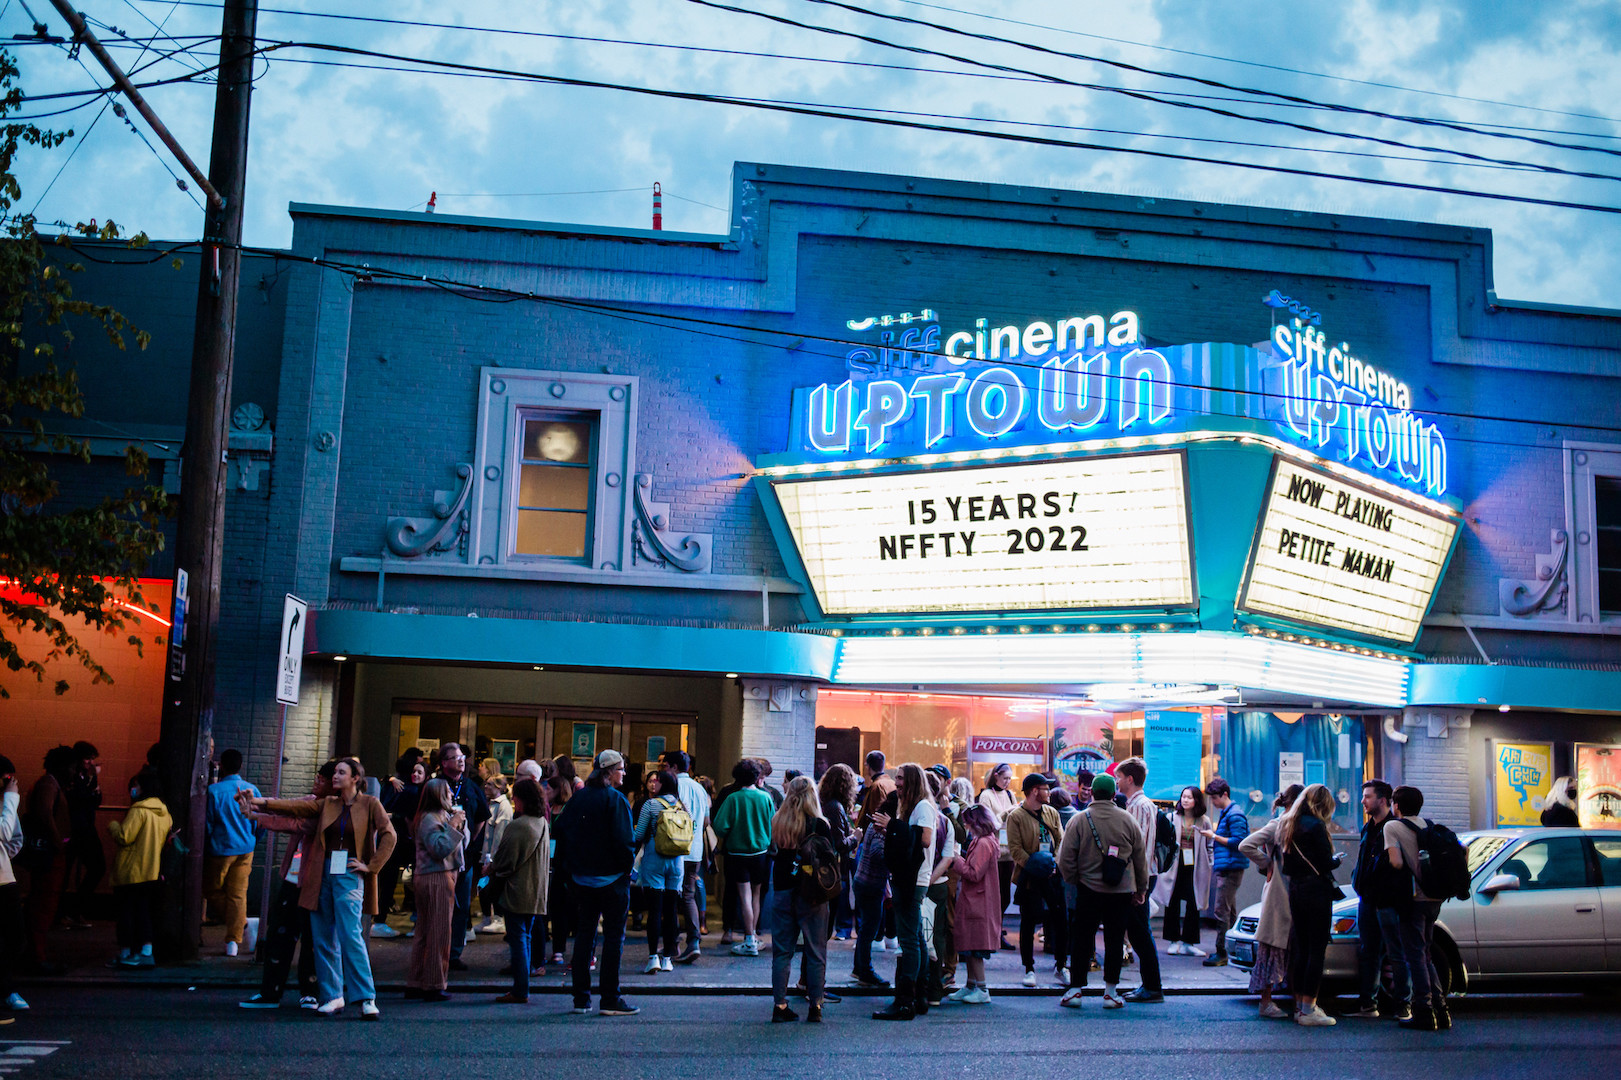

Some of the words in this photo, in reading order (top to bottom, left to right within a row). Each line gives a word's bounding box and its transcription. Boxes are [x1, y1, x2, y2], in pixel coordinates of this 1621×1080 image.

[944, 310, 1140, 366] cinema
[808, 348, 1172, 454] UPTOWN
[1328, 342, 1412, 410] cinema
[1283, 356, 1447, 496] UPTOWN
[908, 499, 937, 526] 15
[945, 491, 1079, 522] YEARS!
[1287, 473, 1326, 509] NOW
[1334, 489, 1393, 533] PLAYING
[879, 530, 977, 561] NFFTY
[1006, 525, 1089, 555] 2022
[1278, 527, 1335, 567] PETITE
[1341, 546, 1395, 583] MAMAN
[974, 740, 1041, 753] POPCORN
[1175, 726, 1198, 734] RULES
